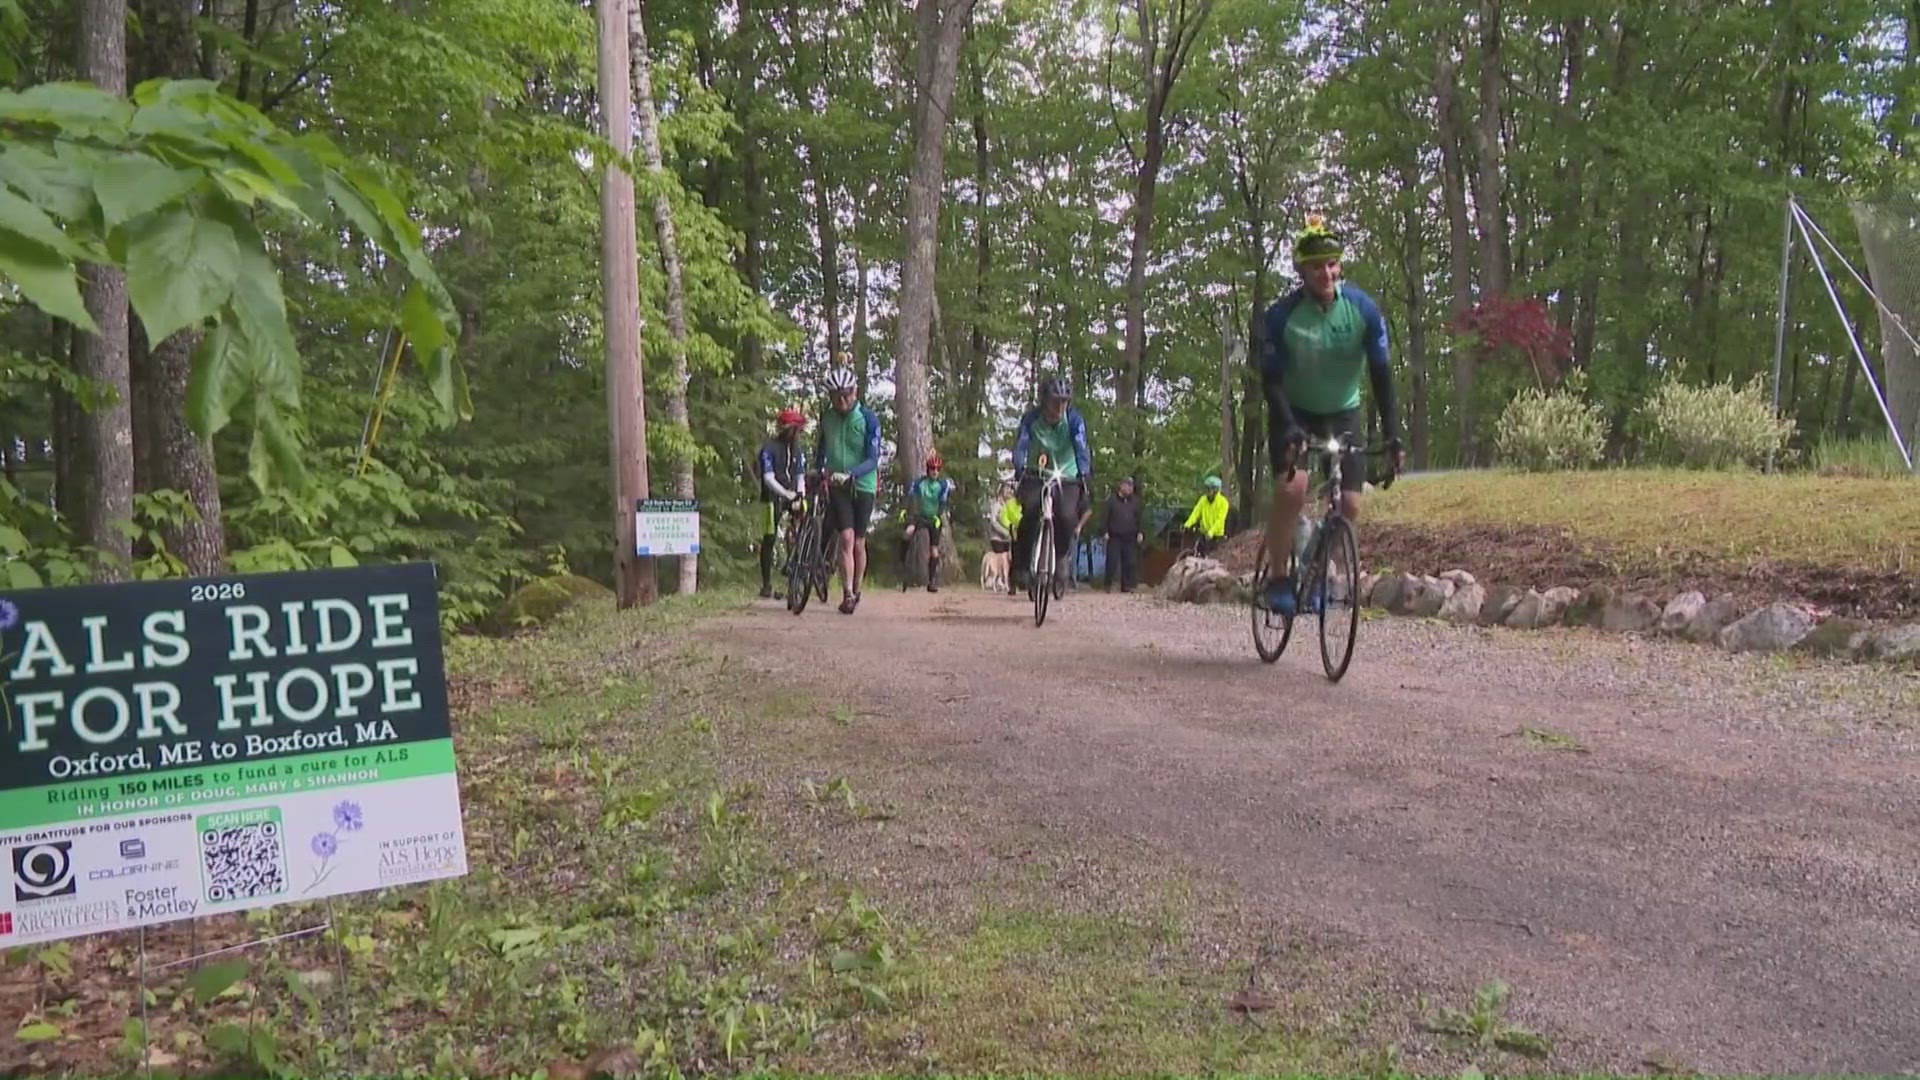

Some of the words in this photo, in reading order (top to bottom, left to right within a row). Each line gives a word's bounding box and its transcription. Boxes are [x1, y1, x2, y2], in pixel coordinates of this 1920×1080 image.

[191, 583, 245, 602] 2026
[10, 609, 191, 680] ALS
[225, 593, 414, 661] RIDE
[15, 681, 187, 752] FOR
[214, 658, 422, 730] HOPE
[49, 749, 151, 778] Oxford,
[159, 743, 203, 763] ME
[211, 740, 237, 760] to
[246, 727, 348, 755] Boxford,
[355, 719, 398, 742] MA
[48, 786, 110, 804] Riding
[118, 781, 146, 796] 150
[152, 773, 204, 793] MILES
[213, 771, 230, 783] to
[238, 762, 278, 780] fund
[284, 764, 293, 774] a
[301, 756, 337, 772] cure
[344, 753, 367, 768] for
[374, 749, 409, 763] ALS
[77, 803, 94, 816] IN
[101, 797, 159, 813] HONOR
[165, 792, 186, 804] OF
[191, 785, 240, 801] DOUG,
[245, 778, 287, 793] MARY
[293, 779, 302, 789] &
[307, 768, 379, 786] SHANNON
[25, 826, 86, 842] GRATITUDE
[90, 823, 110, 834] FOR
[114, 819, 136, 830] OUR
[138, 813, 193, 827] SPONSORS
[208, 813, 240, 827] SCAN
[241, 808, 271, 824] HERE
[379, 840, 390, 849] IN
[393, 833, 440, 847] SUPPORT
[442, 831, 456, 840] OF
[378, 849, 408, 867] ALS
[415, 845, 457, 863] Hope
[88, 860, 180, 881] COLORNINE
[125, 886, 177, 905] Foster
[127, 906, 137, 917] &
[139, 898, 198, 919] Motley
